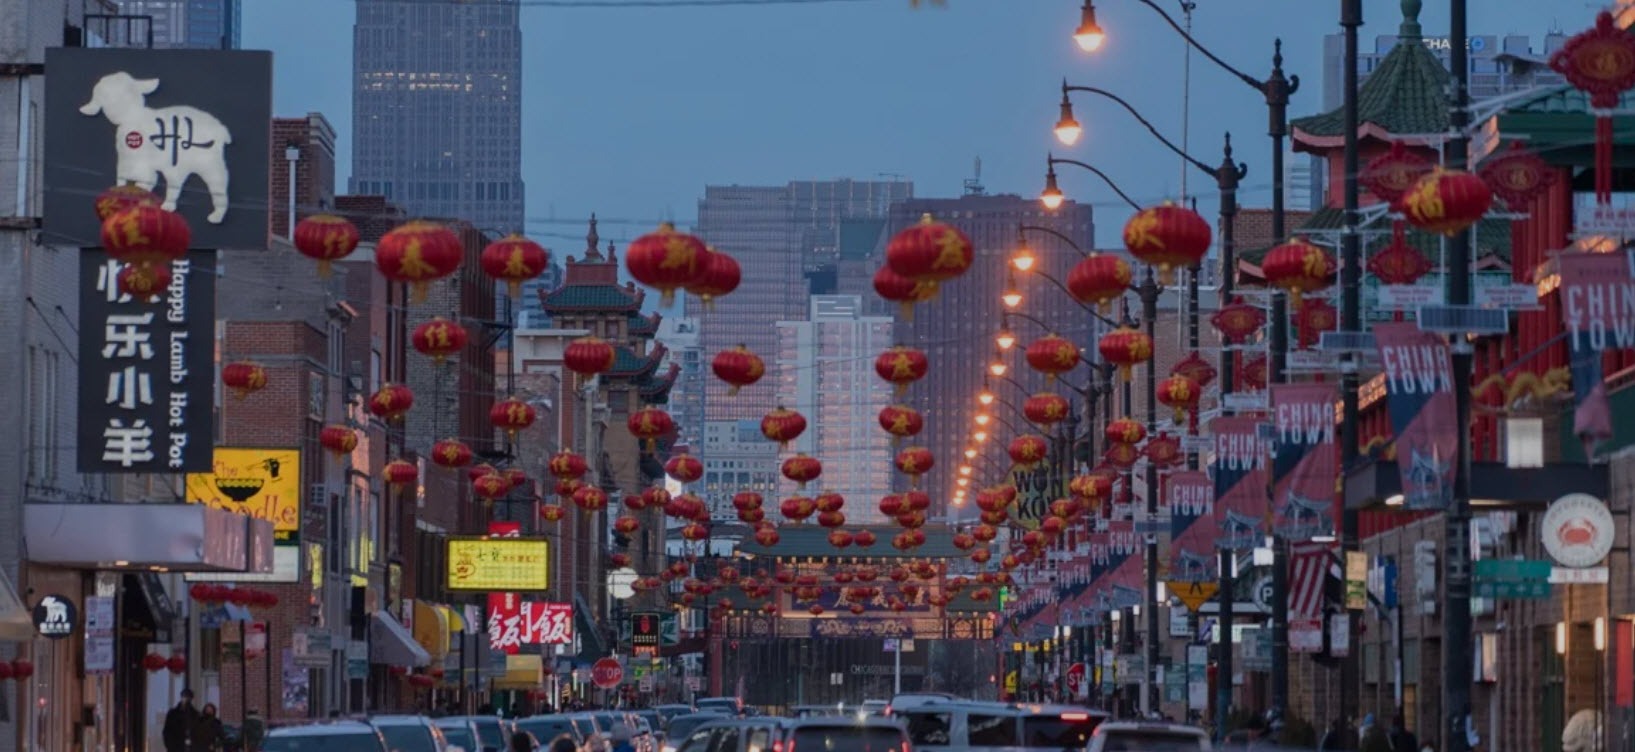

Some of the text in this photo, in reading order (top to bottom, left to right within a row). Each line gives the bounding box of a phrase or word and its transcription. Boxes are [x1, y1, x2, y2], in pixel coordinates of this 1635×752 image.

[1421, 38, 1471, 50] CHAE
[1568, 284, 1635, 321] CHIN
[1571, 318, 1635, 352] TOW
[166, 258, 190, 468] Happy Lamb Hot Pot
[1383, 345, 1448, 371] CHINA
[1385, 367, 1451, 395] TOWN
[1280, 402, 1334, 425] CHINA
[1219, 434, 1265, 453] CHINA
[1280, 424, 1334, 445] TOWN
[1219, 452, 1265, 471] TOWN
[1013, 470, 1064, 496] WON
[1173, 486, 1214, 502] CHINA
[1017, 495, 1050, 520] KO
[1173, 501, 1214, 516] TOWN
[594, 667, 622, 680] STOP
[1068, 673, 1085, 686] ST
